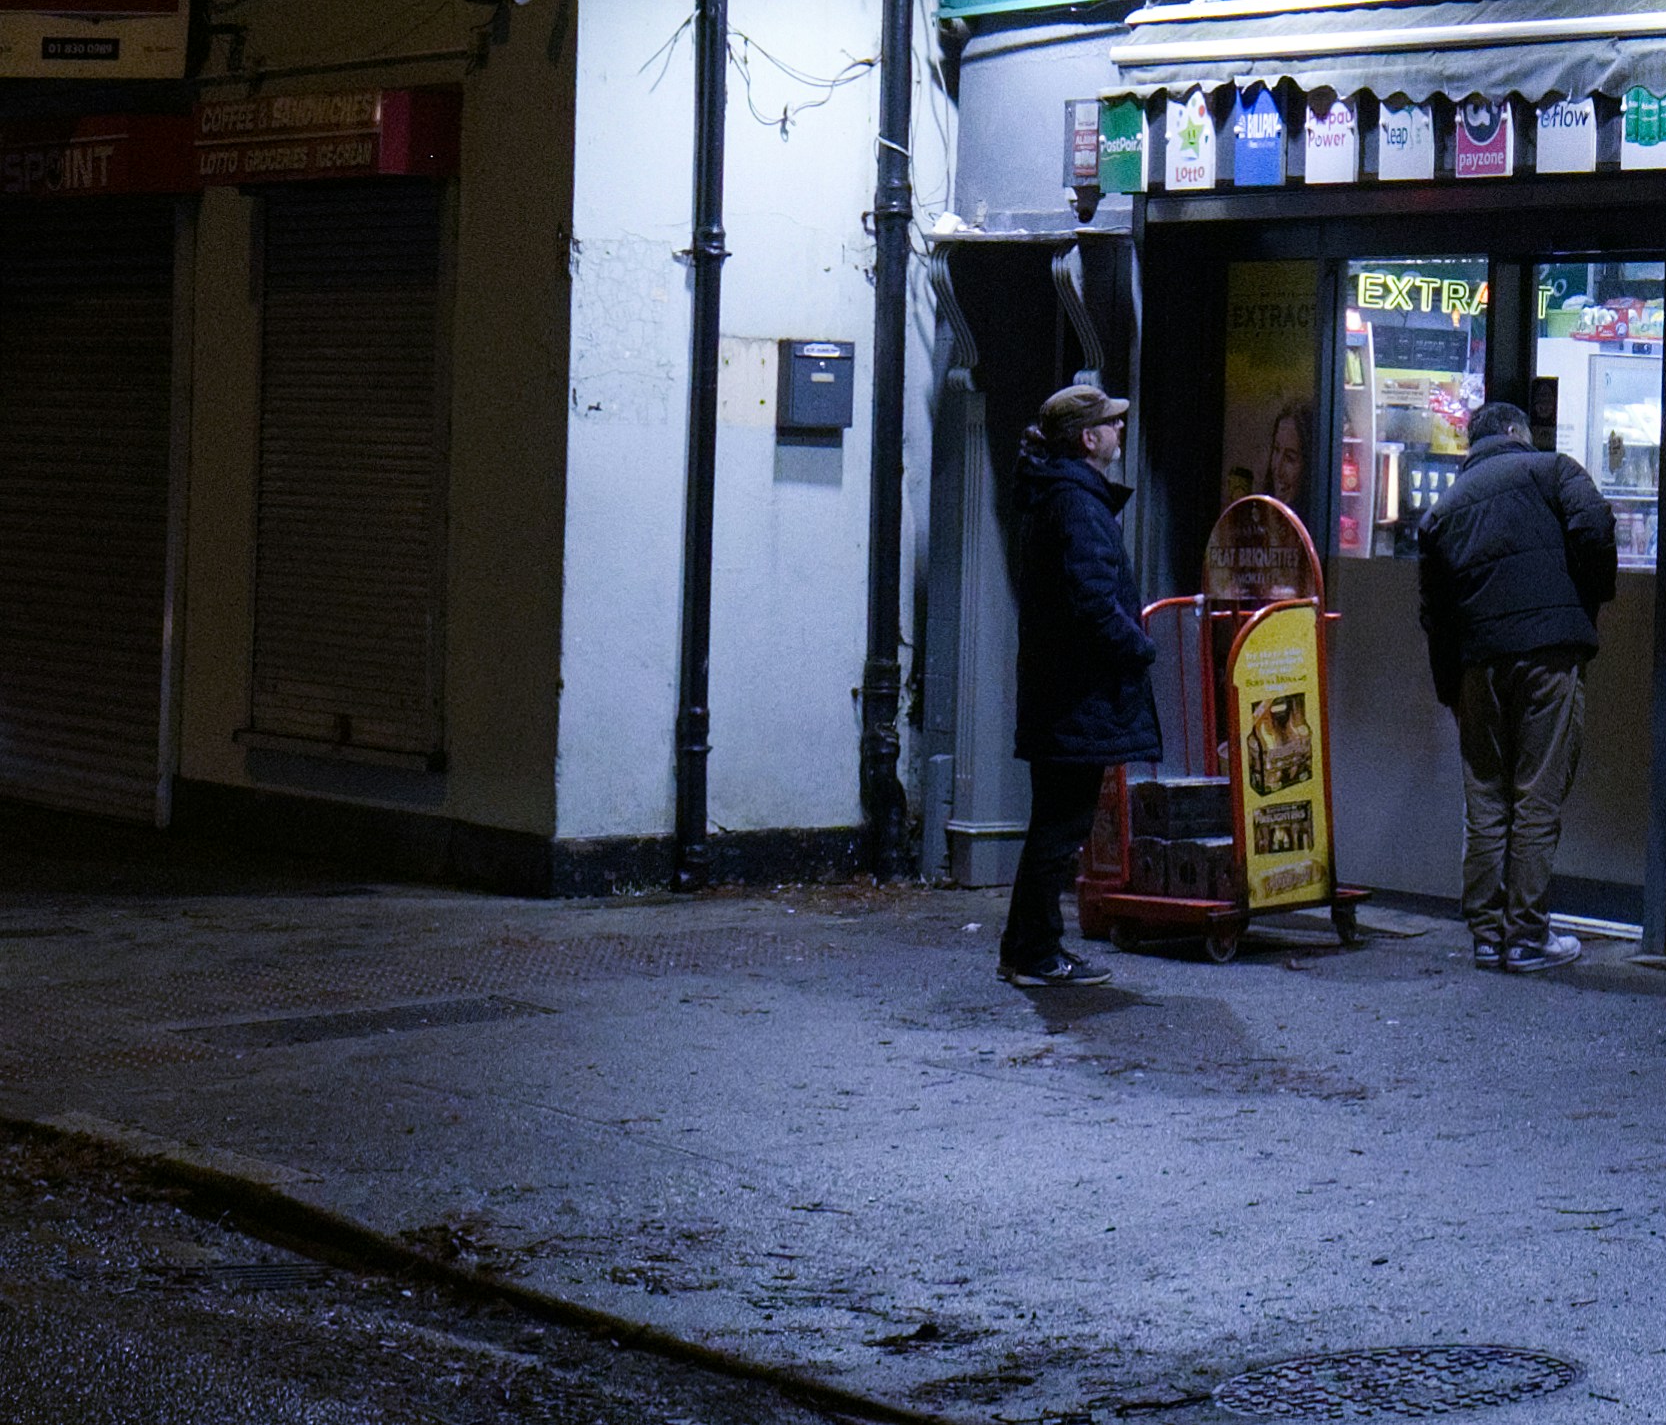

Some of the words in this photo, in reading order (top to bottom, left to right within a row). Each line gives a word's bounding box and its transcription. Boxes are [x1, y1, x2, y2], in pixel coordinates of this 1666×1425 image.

[200, 103, 257, 135] COFFEE
[1307, 130, 1346, 149] Power
[199, 149, 239, 176] LOTTO
[1458, 149, 1505, 171] payzone
